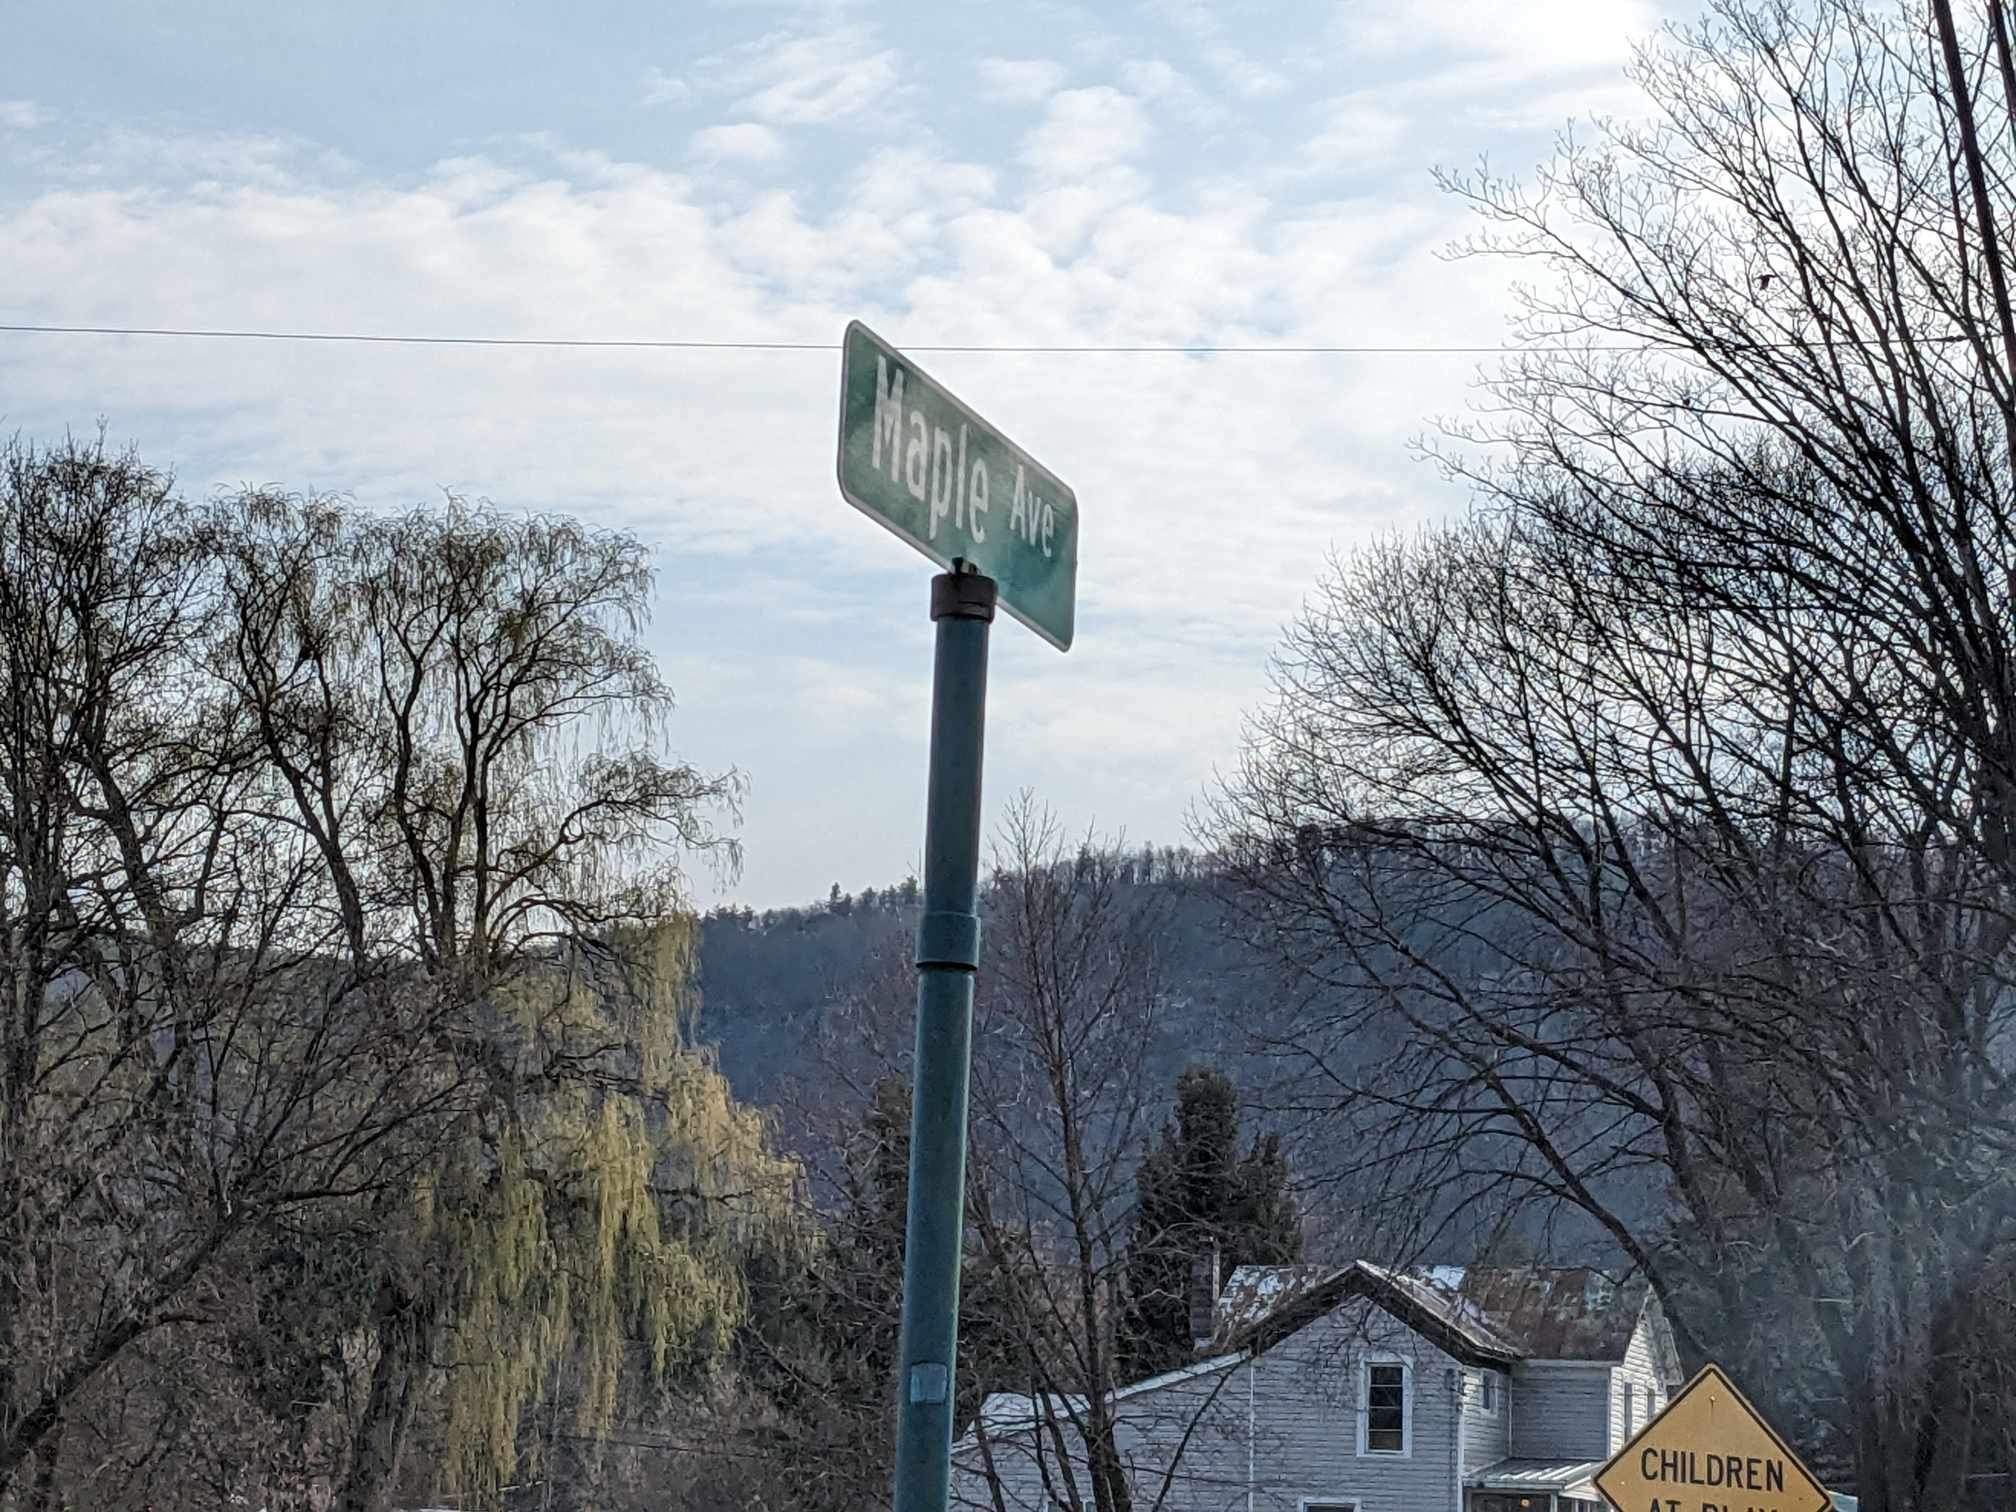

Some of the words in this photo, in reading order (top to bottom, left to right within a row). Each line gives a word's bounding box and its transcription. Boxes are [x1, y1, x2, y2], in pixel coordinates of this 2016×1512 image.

[873, 355, 989, 543] Maple
[1010, 464, 1054, 557] Ave
[1641, 1447, 1784, 1492] CHILDREN
